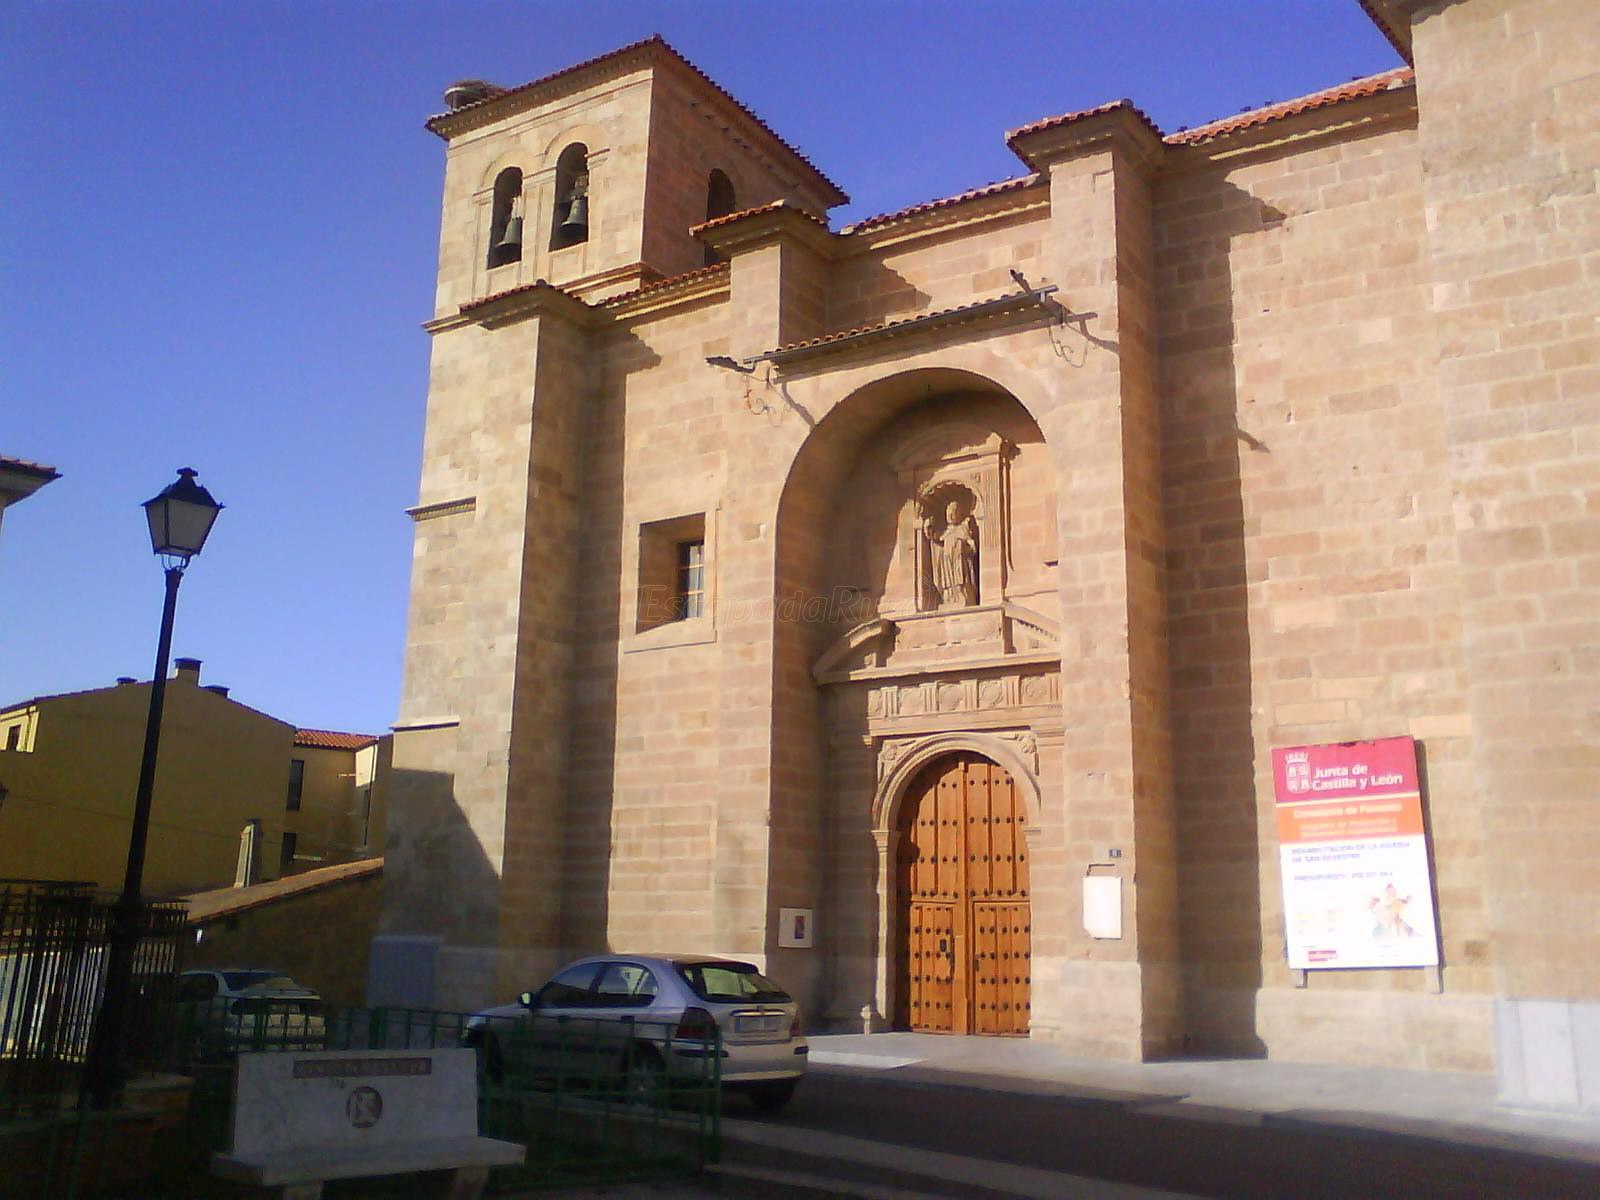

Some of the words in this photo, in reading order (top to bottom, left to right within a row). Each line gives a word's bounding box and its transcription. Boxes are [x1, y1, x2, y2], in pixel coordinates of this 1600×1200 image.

[1314, 766, 1348, 778] Junta
[1352, 764, 1368, 775] de
[1312, 778, 1357, 790] Castilla
[1360, 778, 1367, 790] y
[1371, 774, 1403, 786] León
